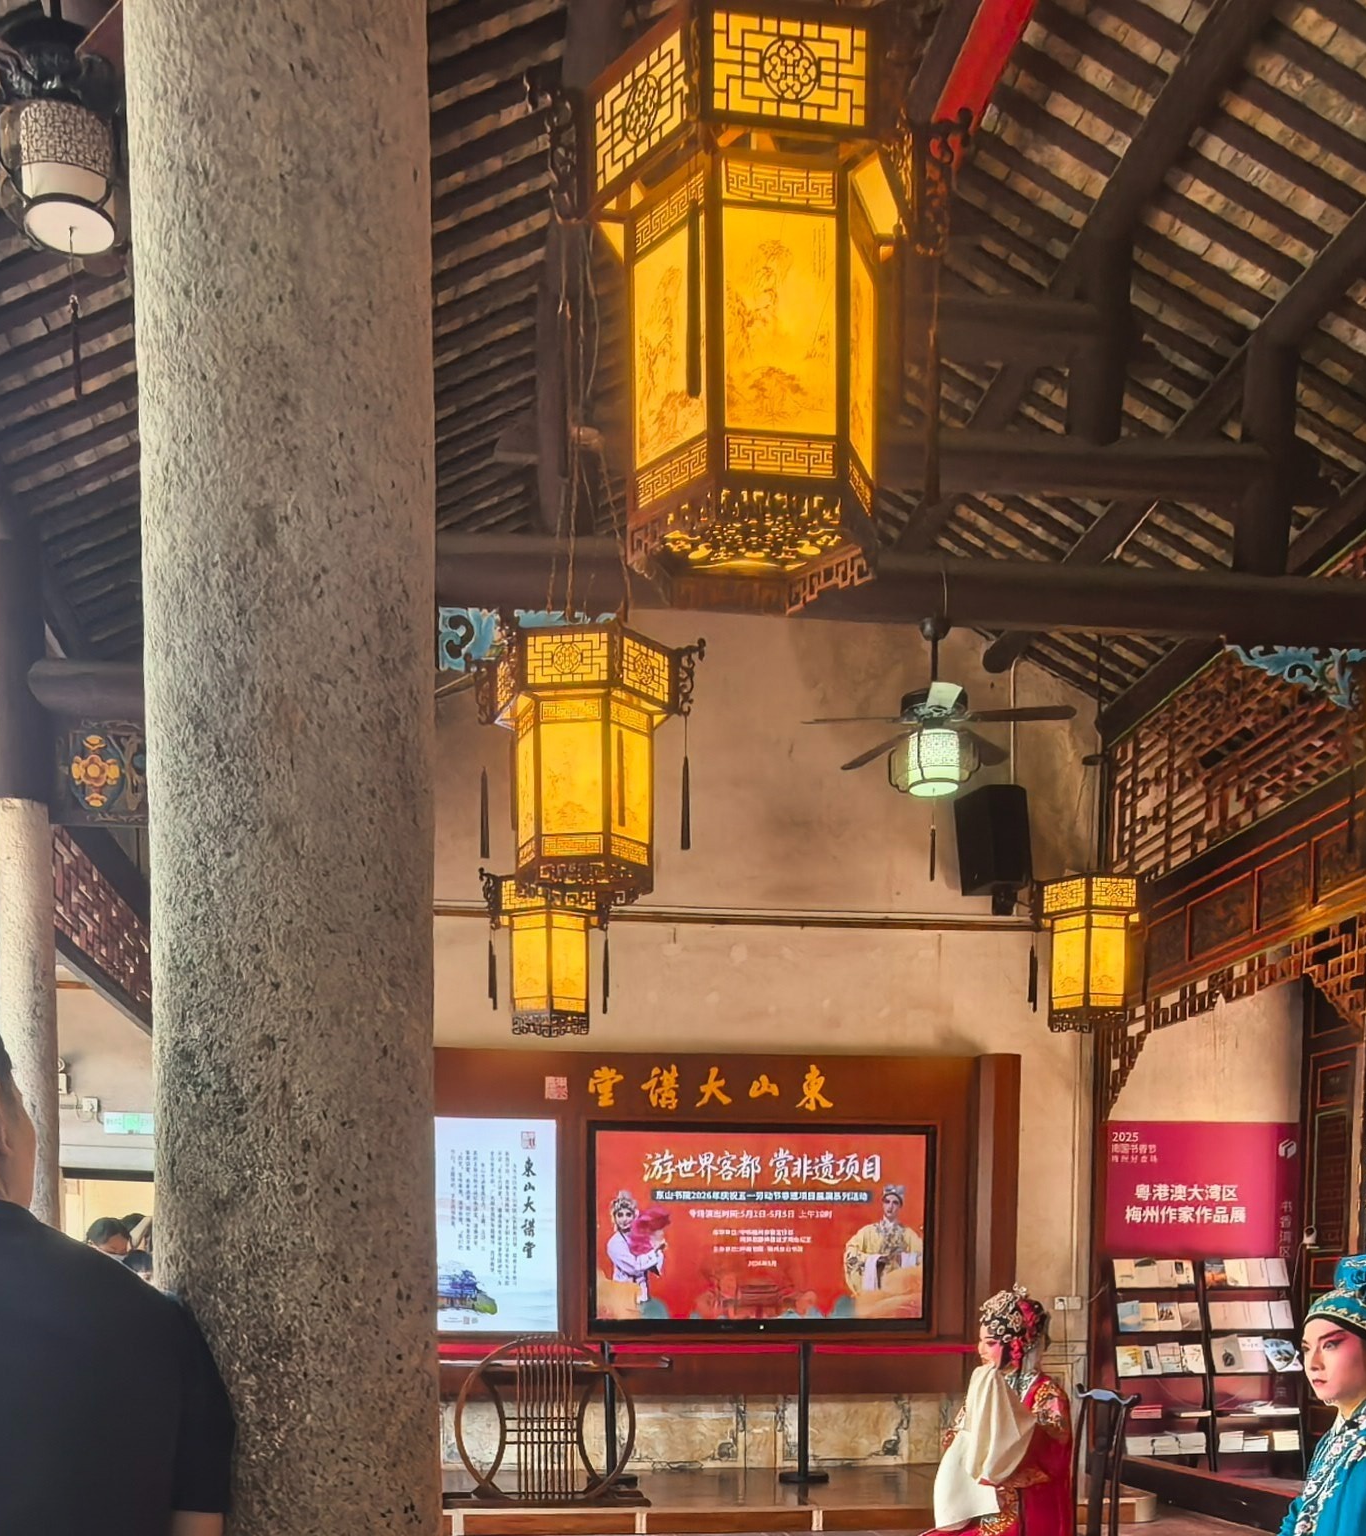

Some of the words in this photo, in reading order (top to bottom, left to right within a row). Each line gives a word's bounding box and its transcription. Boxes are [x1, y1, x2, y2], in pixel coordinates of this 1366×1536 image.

[1112, 1132, 1139, 1142] 2025
[643, 1149, 761, 1186] 游世界客都
[769, 1147, 881, 1185] 赏非遗项目
[1135, 1184, 1239, 1201] 粤港澳大湾区
[1125, 1205, 1247, 1224] 梅州作家作品展
